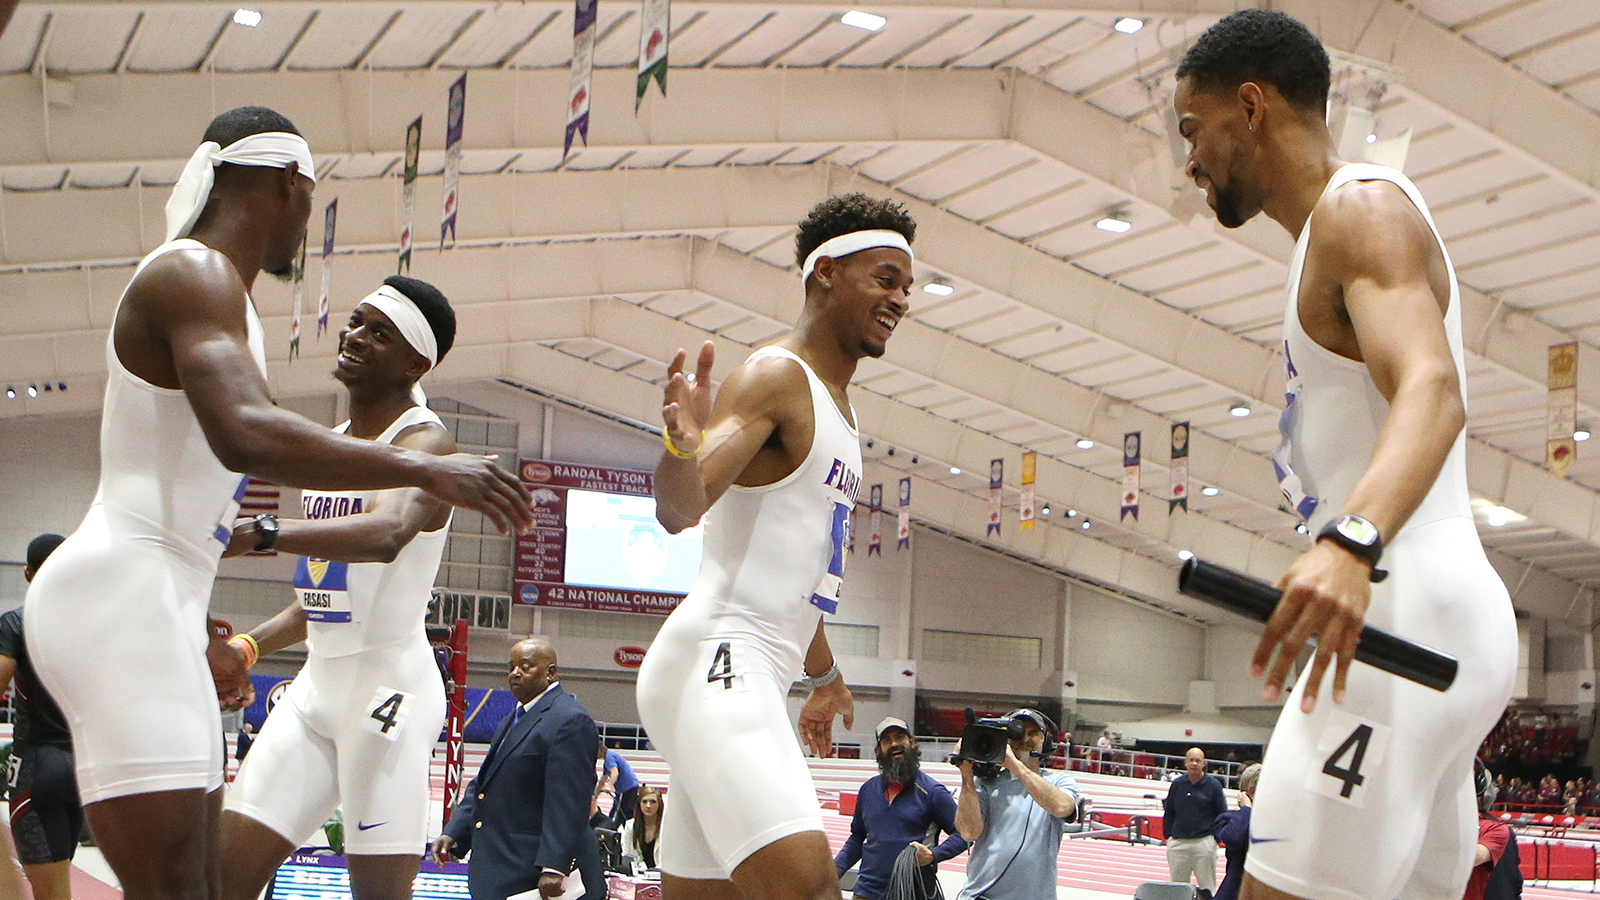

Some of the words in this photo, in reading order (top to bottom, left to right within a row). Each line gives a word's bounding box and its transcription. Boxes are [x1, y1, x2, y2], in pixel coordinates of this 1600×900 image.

[553, 465, 603, 481] RANDAL
[606, 471, 646, 485] TYSON
[580, 480, 619, 490] FASTEST
[621, 483, 649, 494] TRACK
[303, 496, 363, 520] FLORIDA
[304, 592, 331, 608] FASASI
[547, 587, 565, 599] 42
[568, 588, 631, 605] NATIONAL
[619, 649, 645, 663] Tyson
[707, 642, 737, 690] 4
[370, 692, 405, 734] 4
[1321, 723, 1374, 799] 4
[295, 855, 320, 865] LYNX
